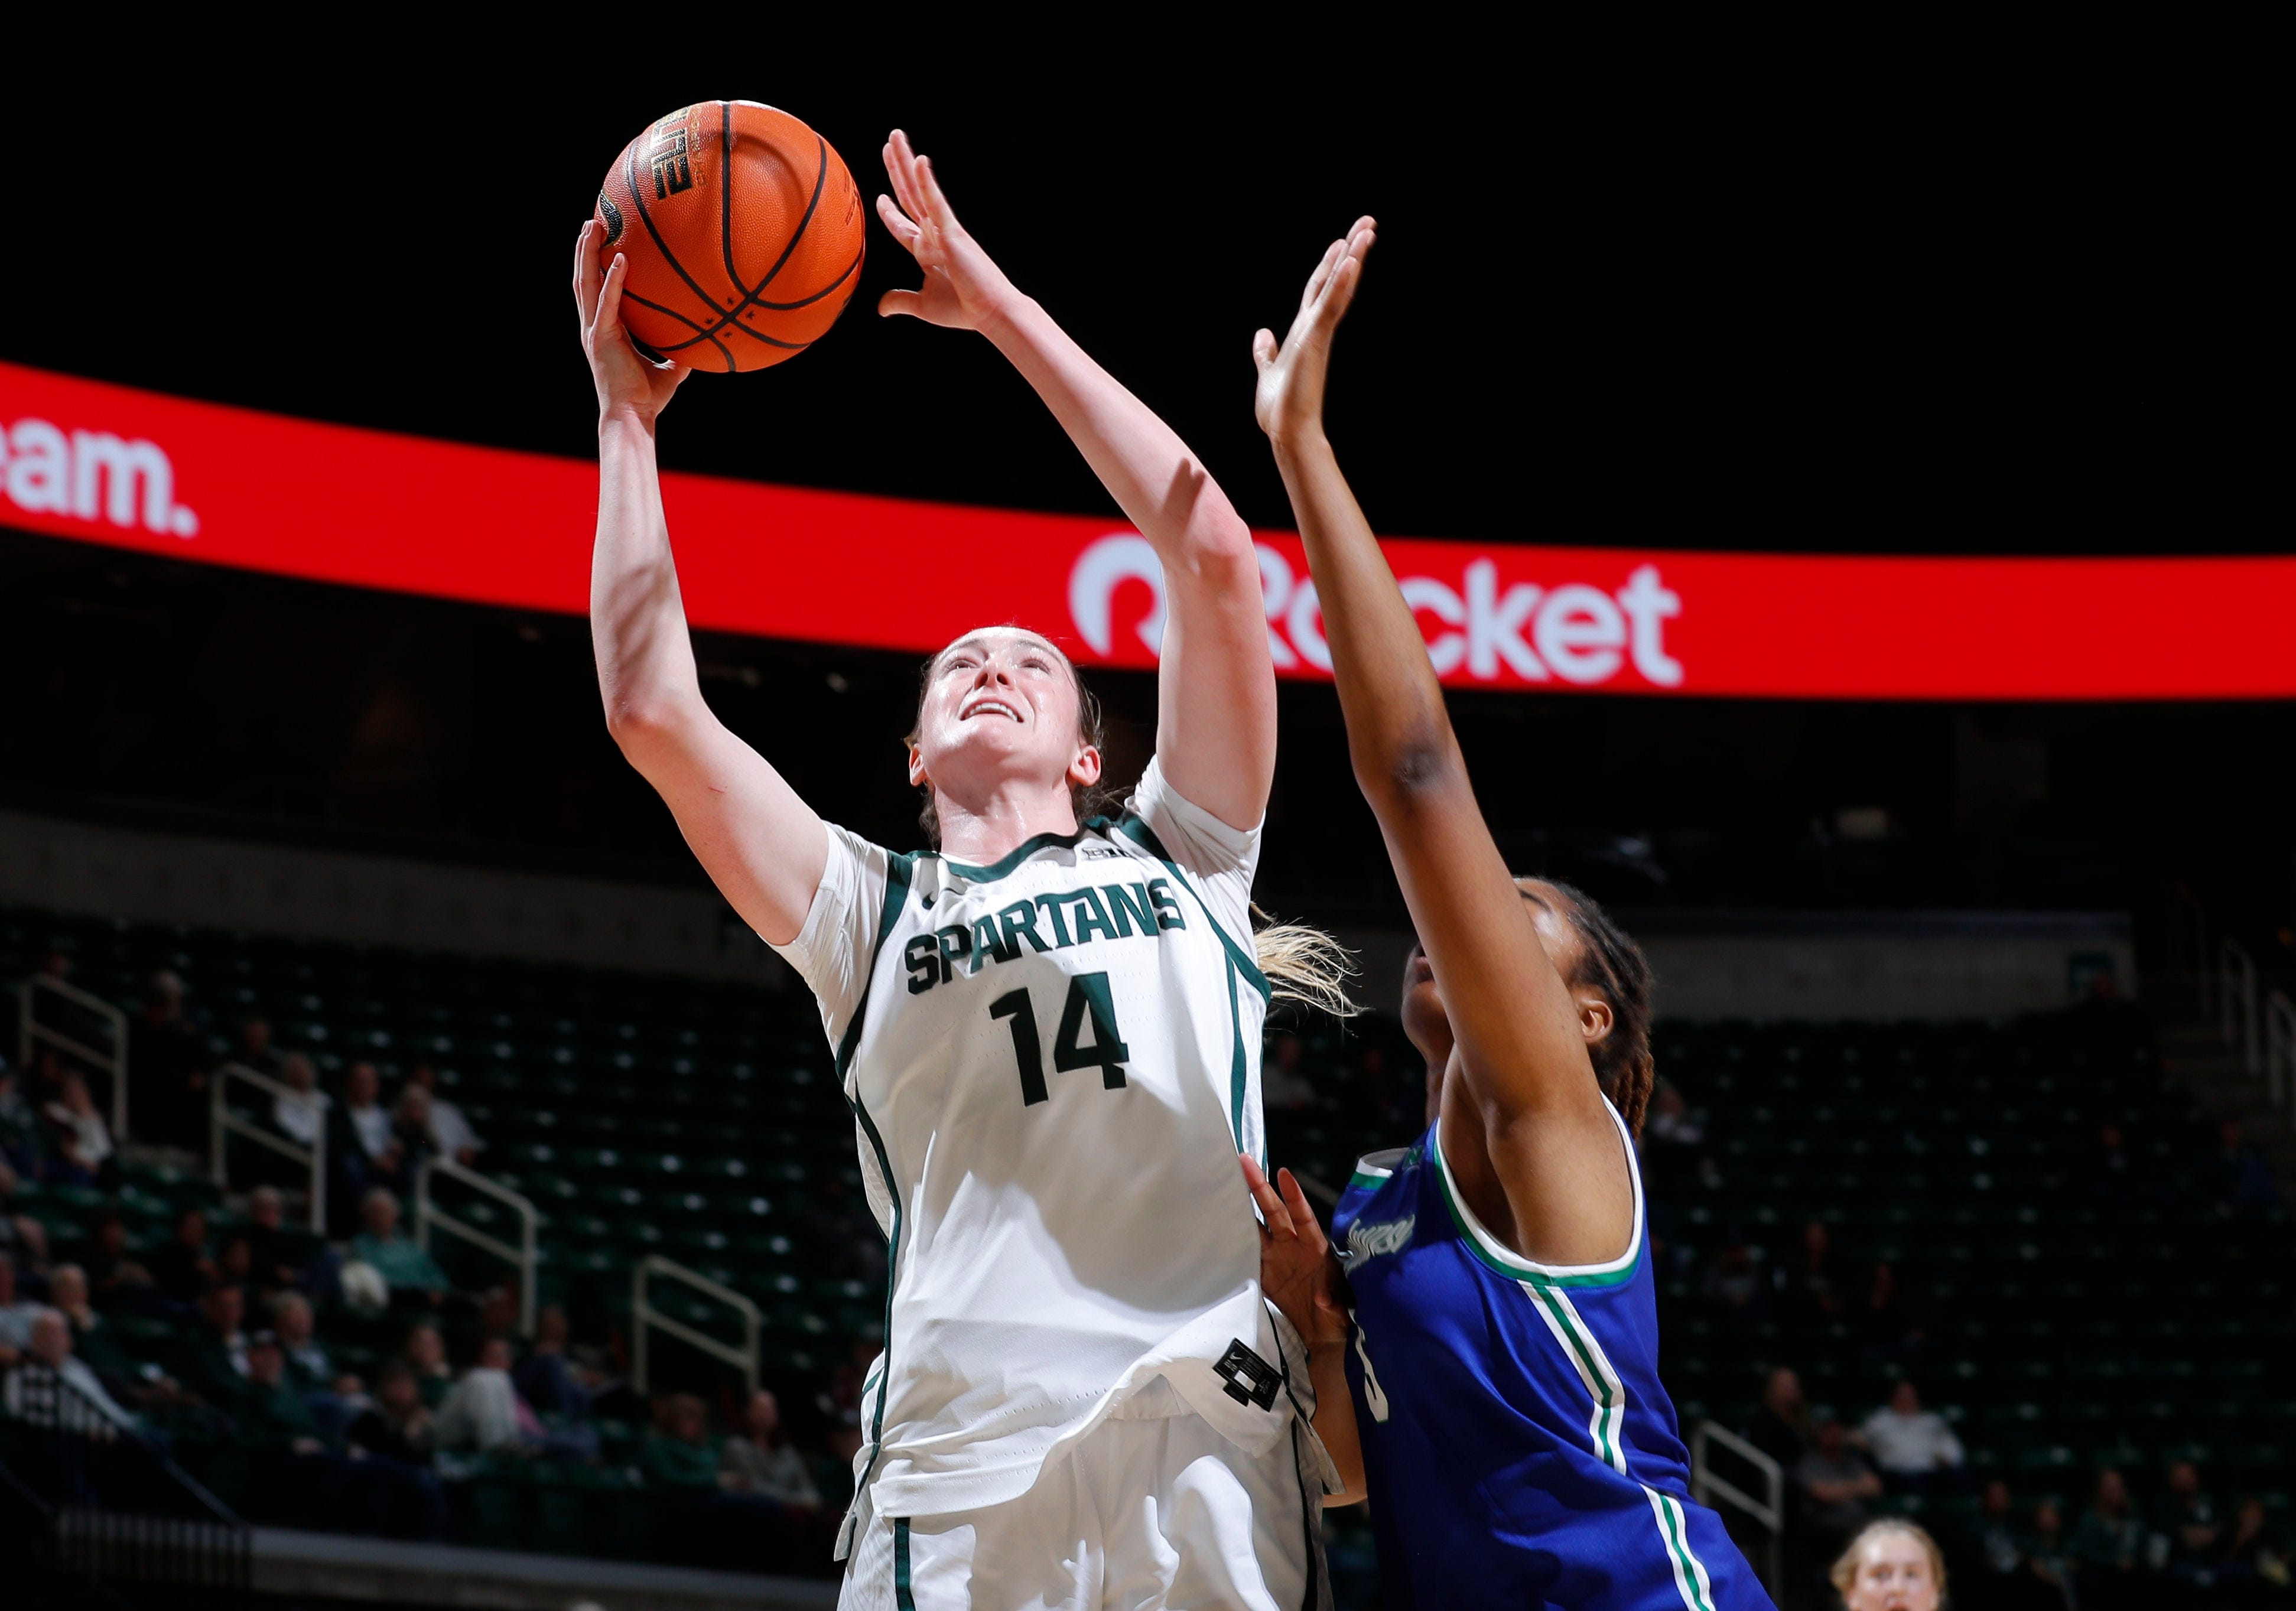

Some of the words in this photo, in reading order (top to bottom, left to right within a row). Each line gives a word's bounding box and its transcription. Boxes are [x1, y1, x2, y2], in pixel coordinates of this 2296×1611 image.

[0, 416, 200, 540] am.
[904, 878, 1186, 995] SPARTANS
[988, 971, 1130, 1107] 14
